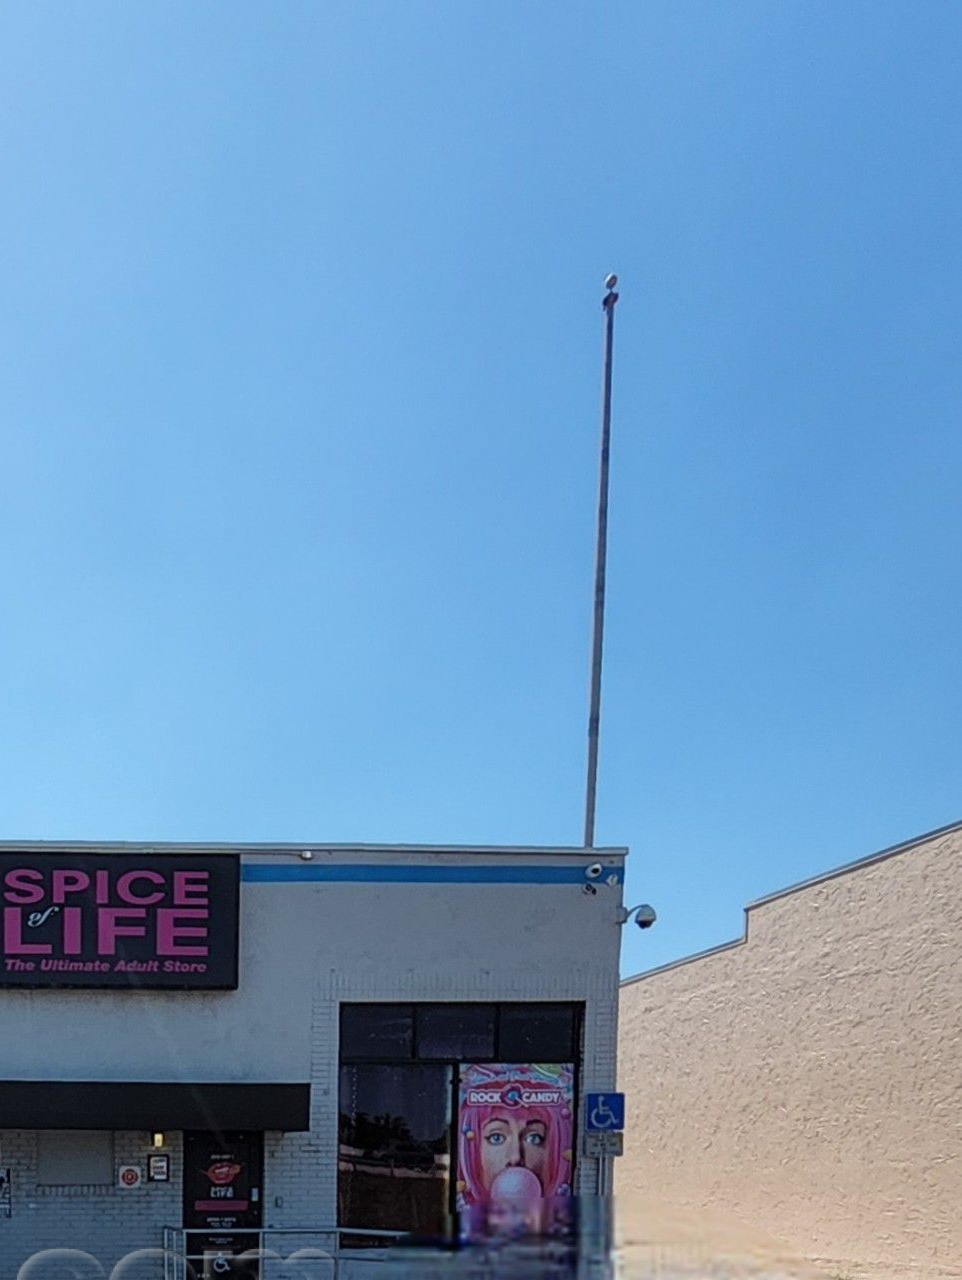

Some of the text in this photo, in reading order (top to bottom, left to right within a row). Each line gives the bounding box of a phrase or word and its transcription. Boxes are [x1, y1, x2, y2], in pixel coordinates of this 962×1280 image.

[3, 868, 209, 905] SPICE
[27, 906, 59, 927] of
[3, 906, 209, 956] LIFE
[4, 959, 207, 973] The Ultimate Adult Store
[470, 1092, 561, 1104] ROCK CANDY
